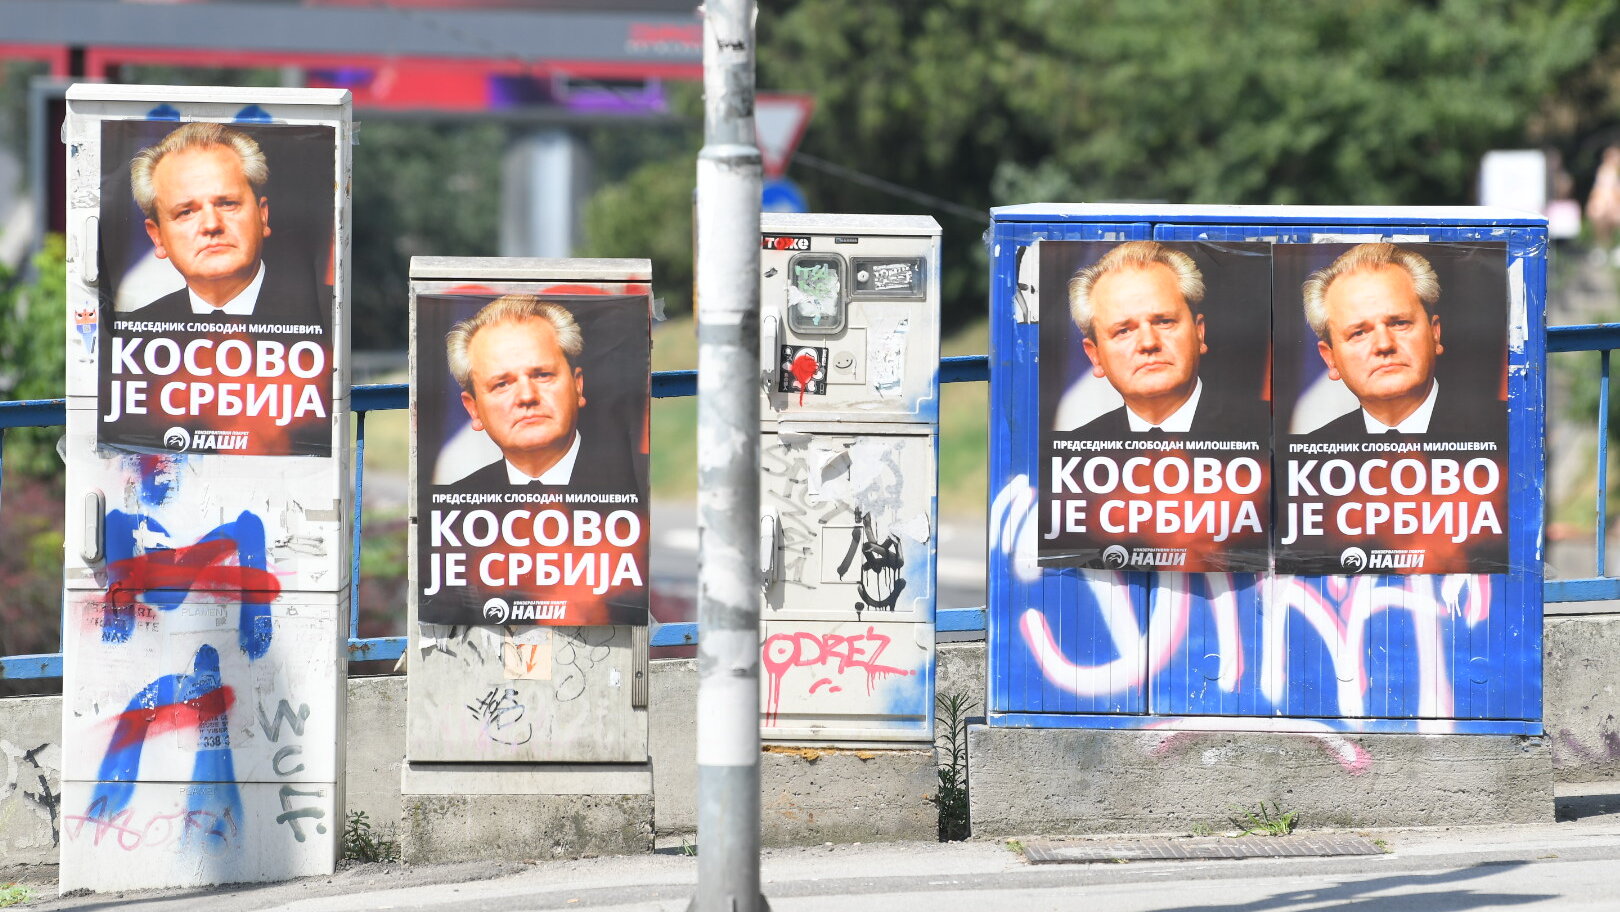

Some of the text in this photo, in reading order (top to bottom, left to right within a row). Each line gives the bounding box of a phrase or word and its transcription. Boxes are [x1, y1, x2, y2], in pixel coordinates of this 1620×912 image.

[115, 321, 322, 334] ПРЕДСЕДНИК СЛОБОДАН МИЛОШЕВИЋ
[112, 337, 324, 378] КОСОВО
[104, 381, 326, 426] ЈЕ СРБИЈА
[192, 435, 248, 449] НАШИ
[1054, 441, 1259, 451] ПРЕДСЕДНИК СЛОБОДАН МИЛОШЕВИЋ
[1290, 442, 1496, 454] ПРЕДСЕДНИК СЛОБОДАН МИЛОШЕВИЋ
[1052, 457, 1261, 494] КОСОВО
[1289, 458, 1499, 496] КОСОВО
[433, 494, 638, 504] ПРЕДСЕДНИК СЛОБОДАН МИЛОШЕВИЋ
[431, 510, 640, 547] КОСОВО
[1045, 500, 1262, 541] ЈЕ СРБИЈА
[1282, 501, 1502, 544] ЈЕ СРБИЈА
[1131, 553, 1186, 565] НАШИ
[1369, 553, 1424, 568] НАШИ
[424, 553, 642, 595] ЈЕ СРБИЈА
[511, 605, 566, 619] НАШИ
